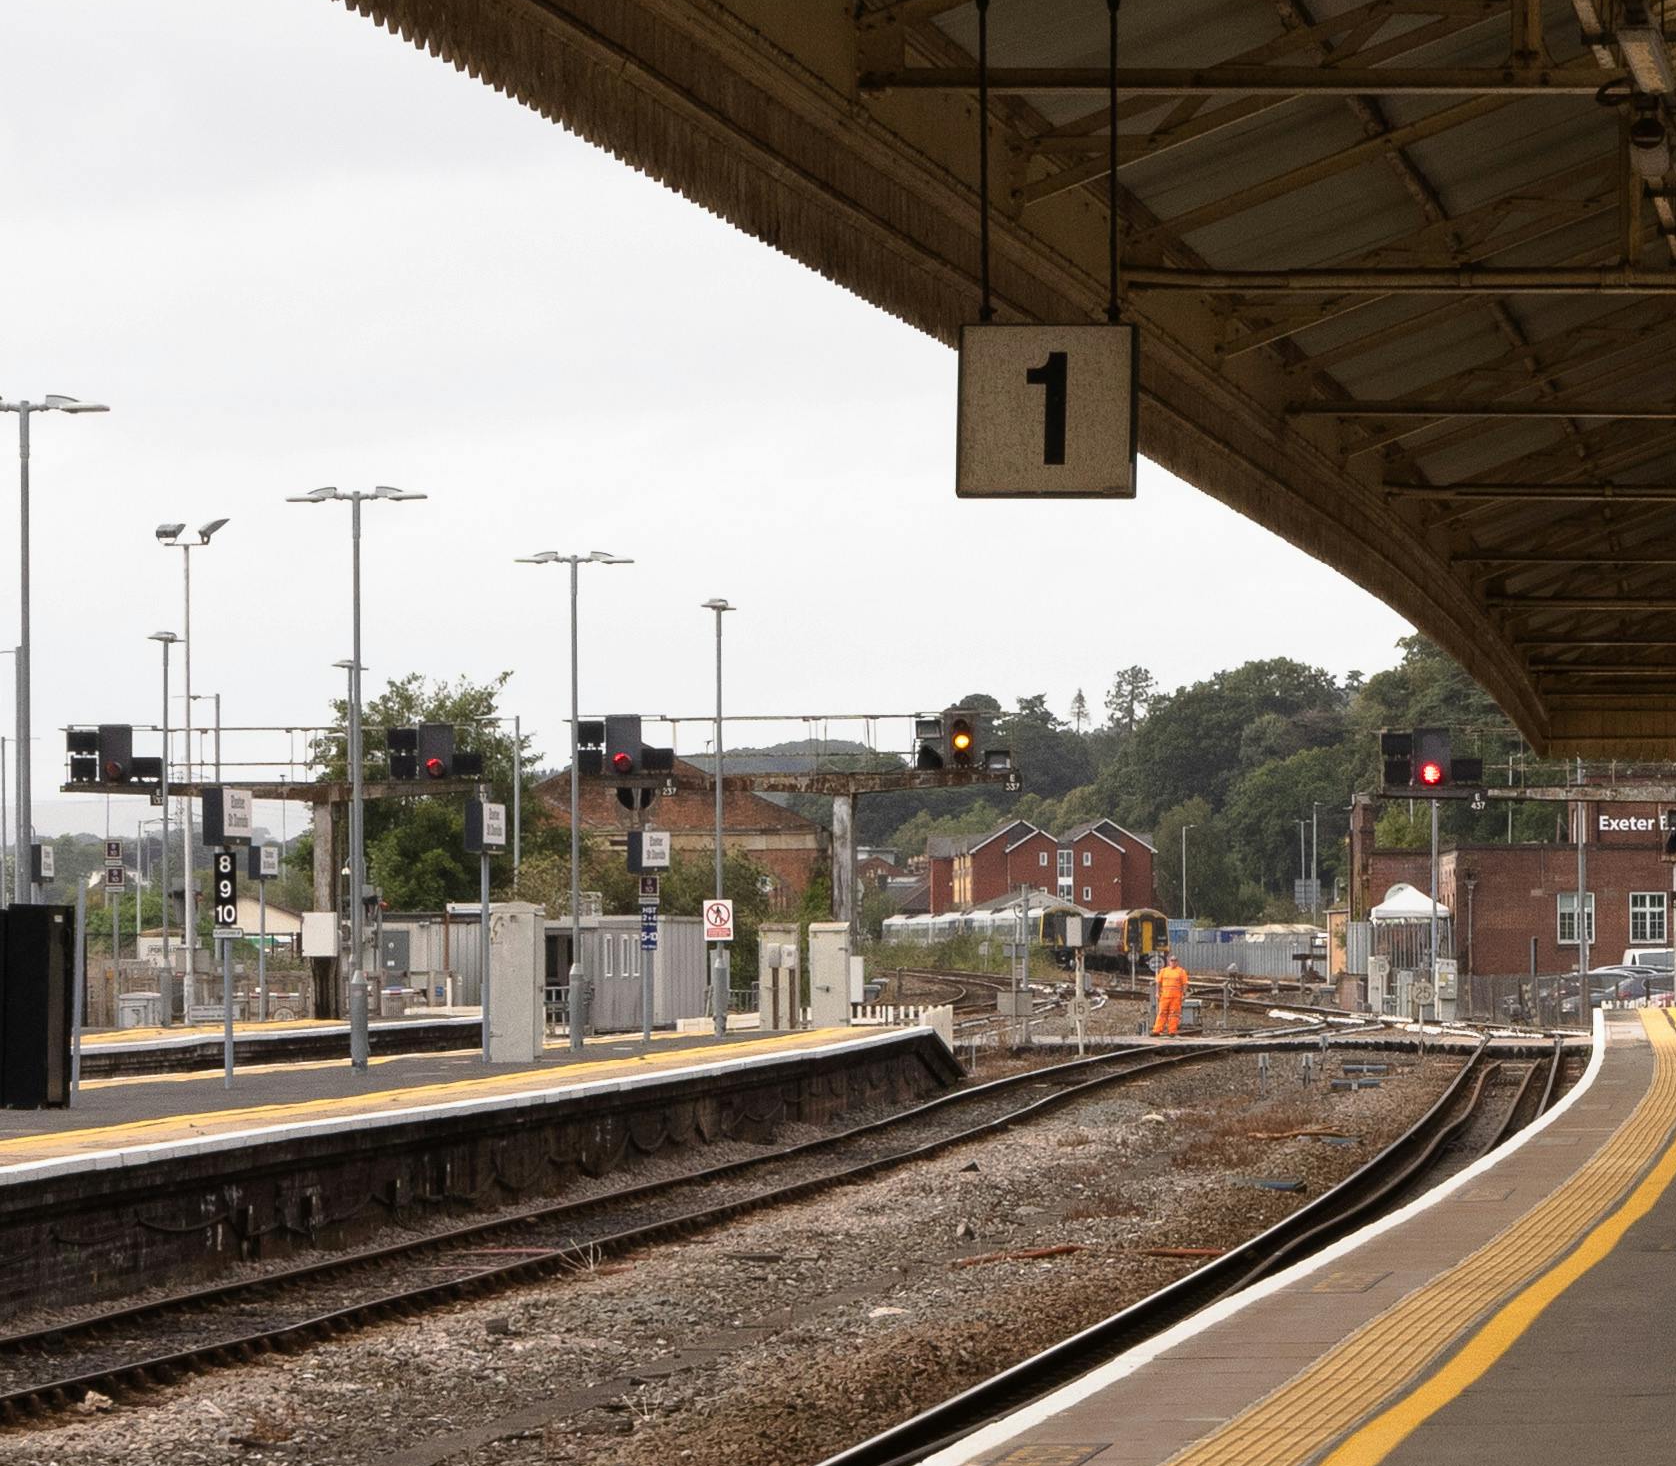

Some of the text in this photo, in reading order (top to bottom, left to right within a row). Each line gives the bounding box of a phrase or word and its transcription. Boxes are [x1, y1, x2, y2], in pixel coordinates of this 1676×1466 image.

[1026, 352, 1068, 465] 1
[1599, 815, 1656, 831] Exeter
[219, 855, 231, 873] 8
[220, 880, 232, 898] 9
[216, 904, 236, 923] 10
[1416, 987, 1431, 1000] 25
[1073, 1001, 1085, 1015] 15
